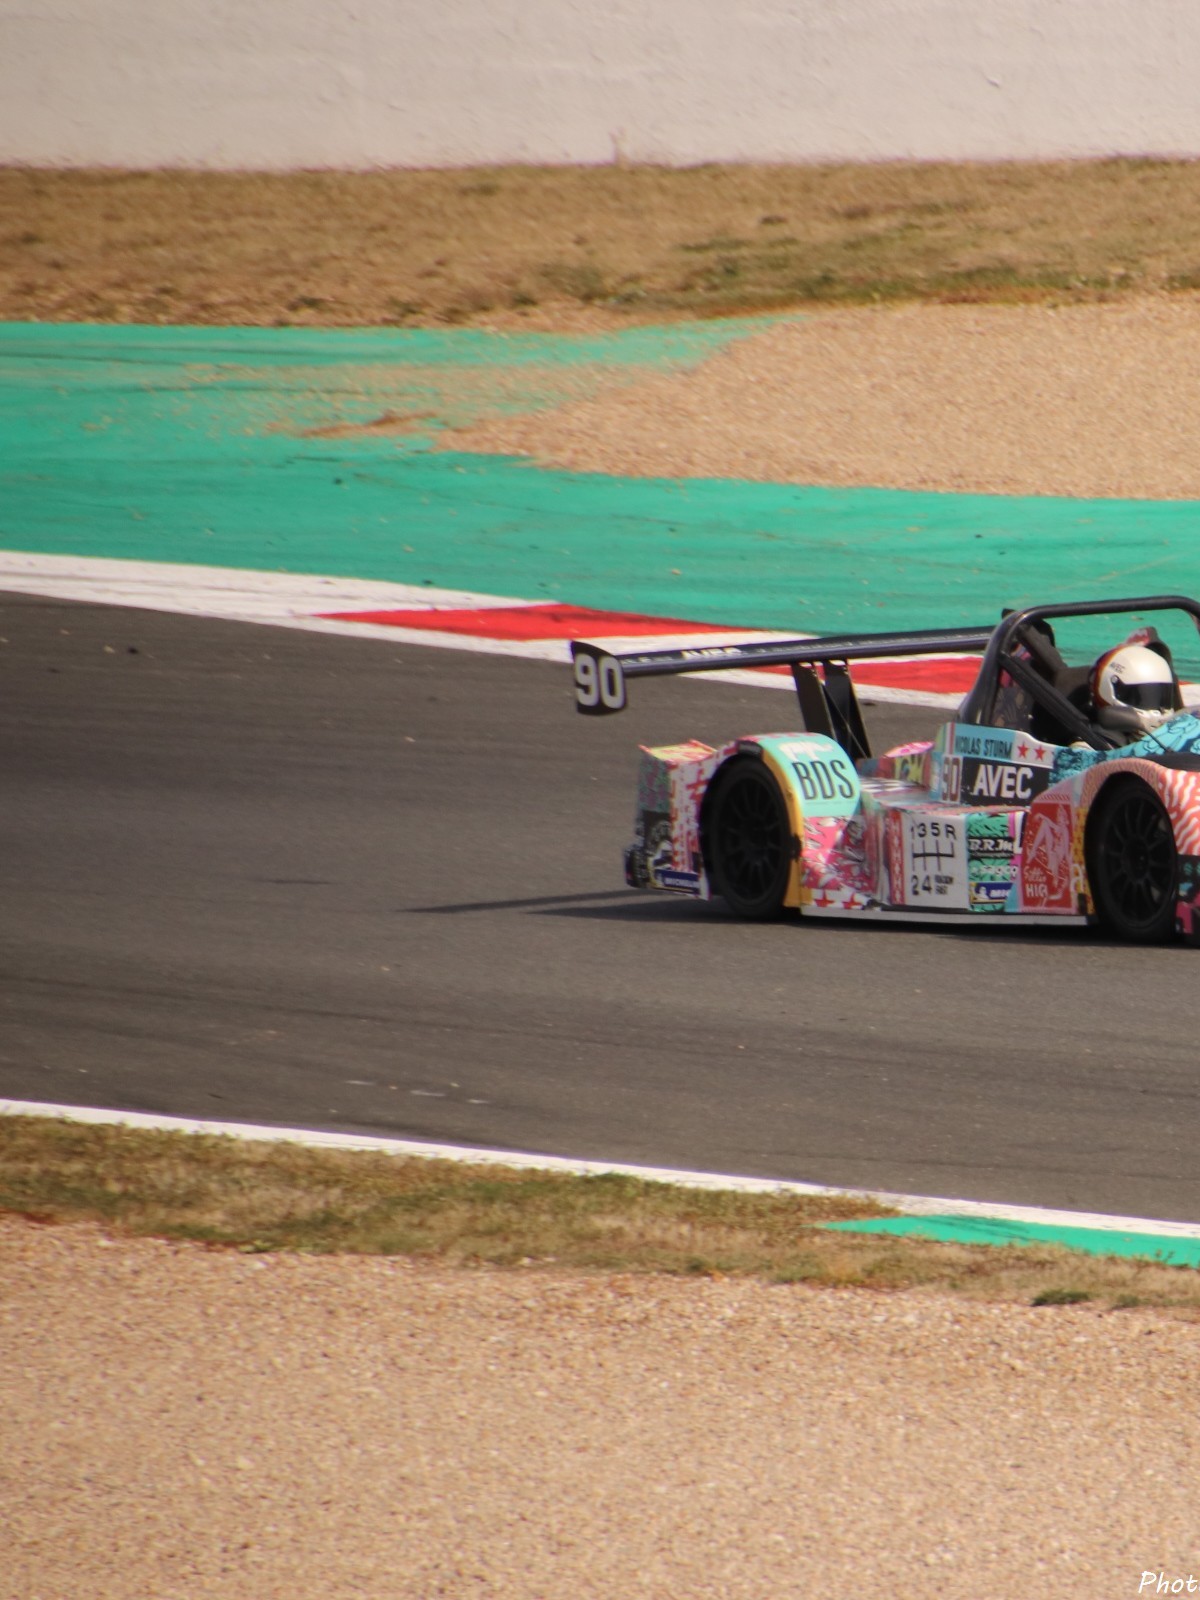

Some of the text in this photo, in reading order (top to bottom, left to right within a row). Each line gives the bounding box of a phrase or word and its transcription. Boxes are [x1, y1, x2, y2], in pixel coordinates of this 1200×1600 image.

[575, 653, 625, 709] 90
[955, 735, 1013, 759] NICOLAS STURM
[792, 759, 854, 800] BDS
[970, 764, 1034, 799] AVEC
